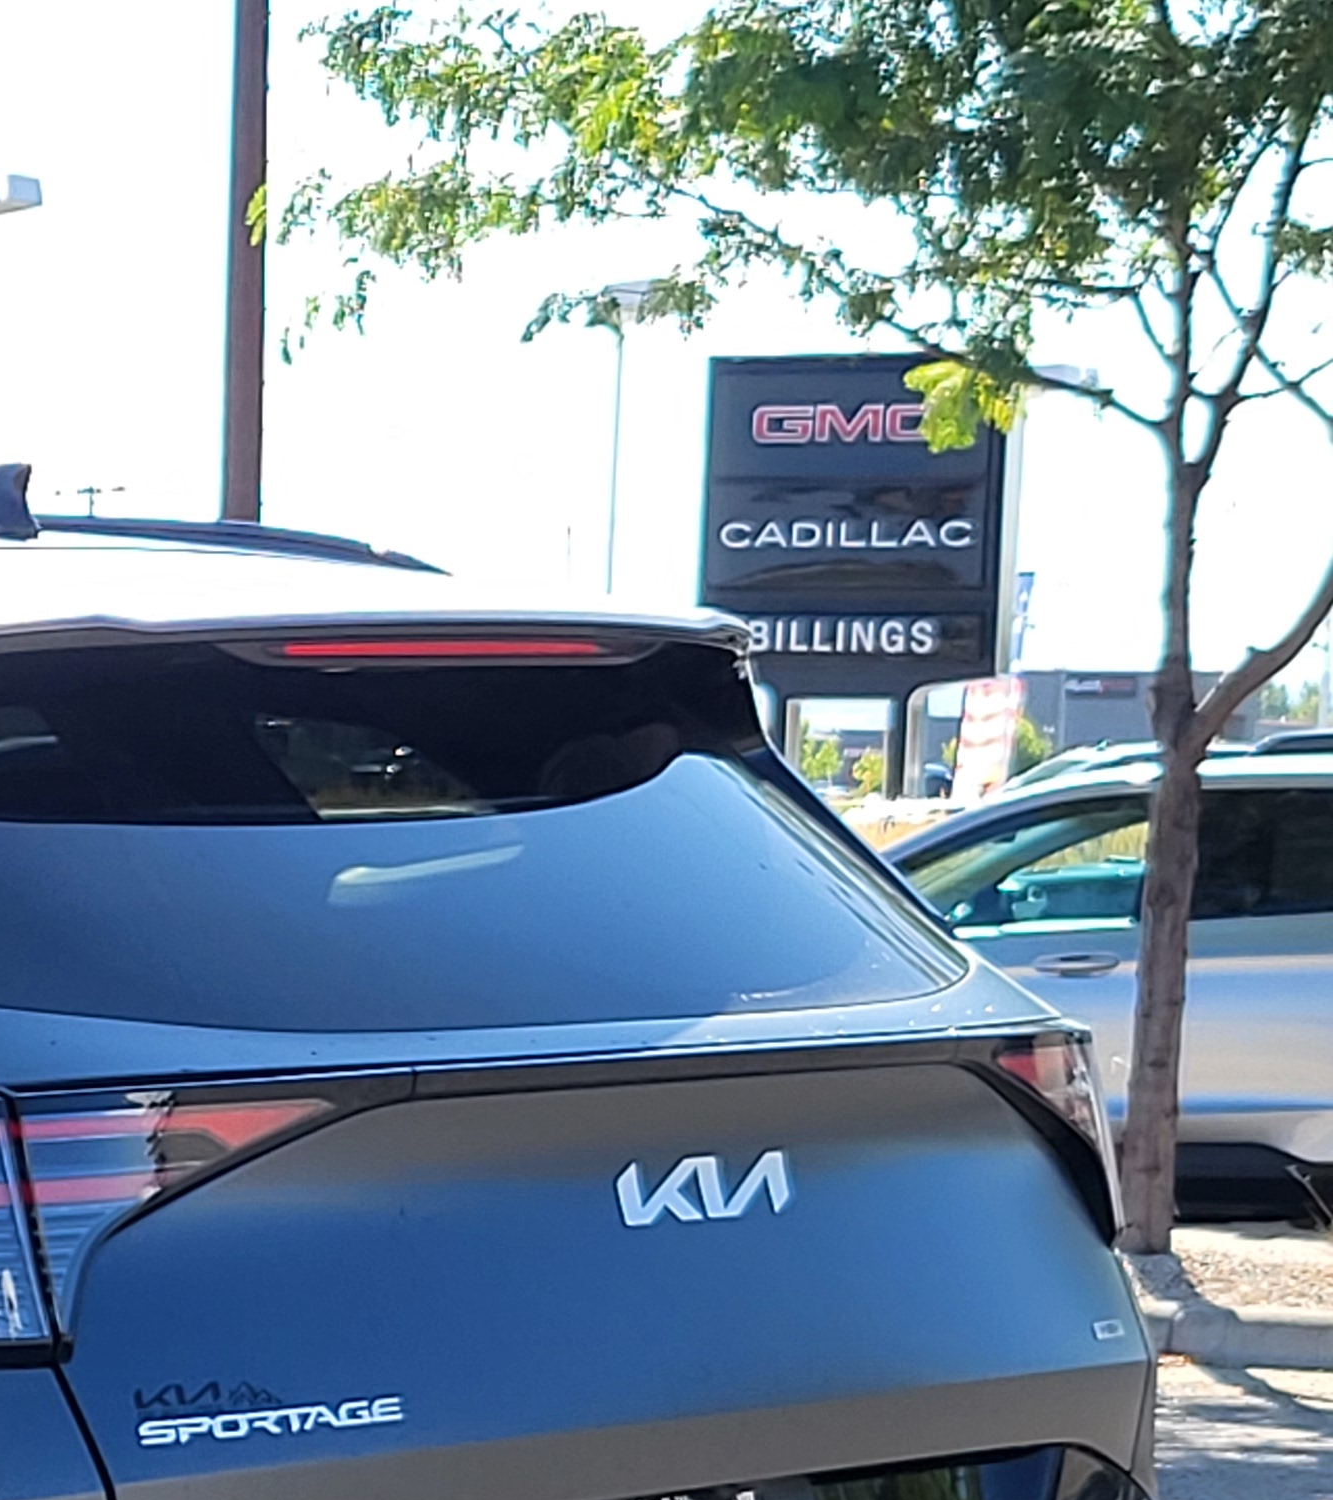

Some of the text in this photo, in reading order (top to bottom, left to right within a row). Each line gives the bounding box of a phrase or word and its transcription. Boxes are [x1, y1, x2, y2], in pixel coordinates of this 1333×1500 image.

[752, 402, 926, 444] GMC
[719, 520, 978, 548] CADILLAC
[748, 618, 936, 655] BILLINGS
[616, 1149, 790, 1228] KIA
[137, 1397, 404, 1447] SPORTAGE
